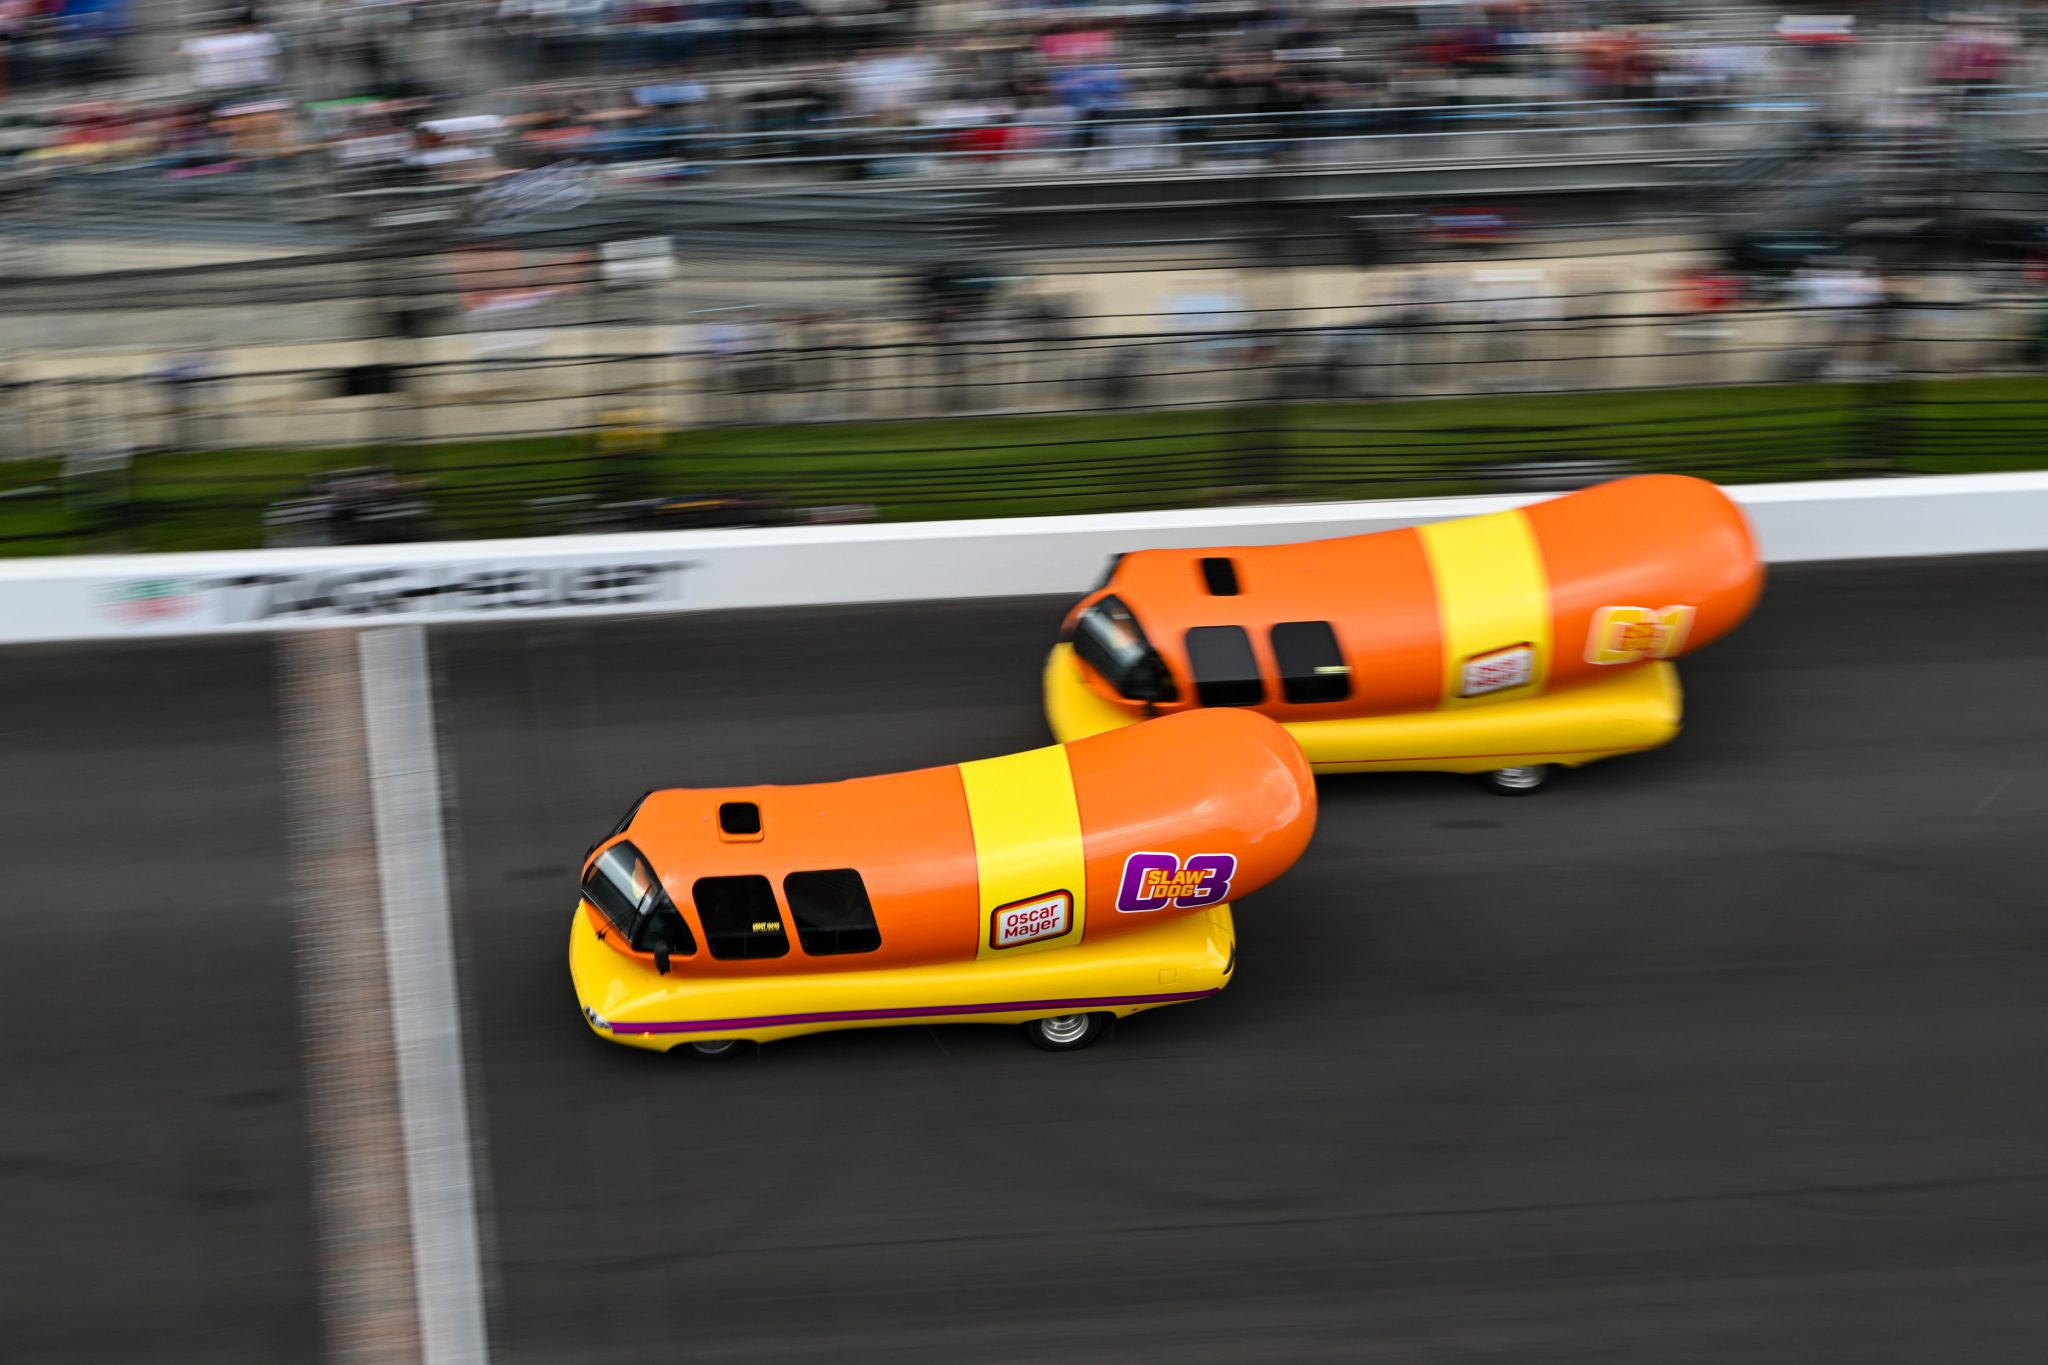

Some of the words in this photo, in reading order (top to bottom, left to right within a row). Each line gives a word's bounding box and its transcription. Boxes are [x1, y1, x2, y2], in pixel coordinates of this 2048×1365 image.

[1116, 851, 1237, 913] 03
[1147, 869, 1206, 886] SLAW
[1152, 884, 1196, 898] DOG
[1007, 904, 1059, 927] Oscar
[1004, 916, 1060, 939] Mayer
